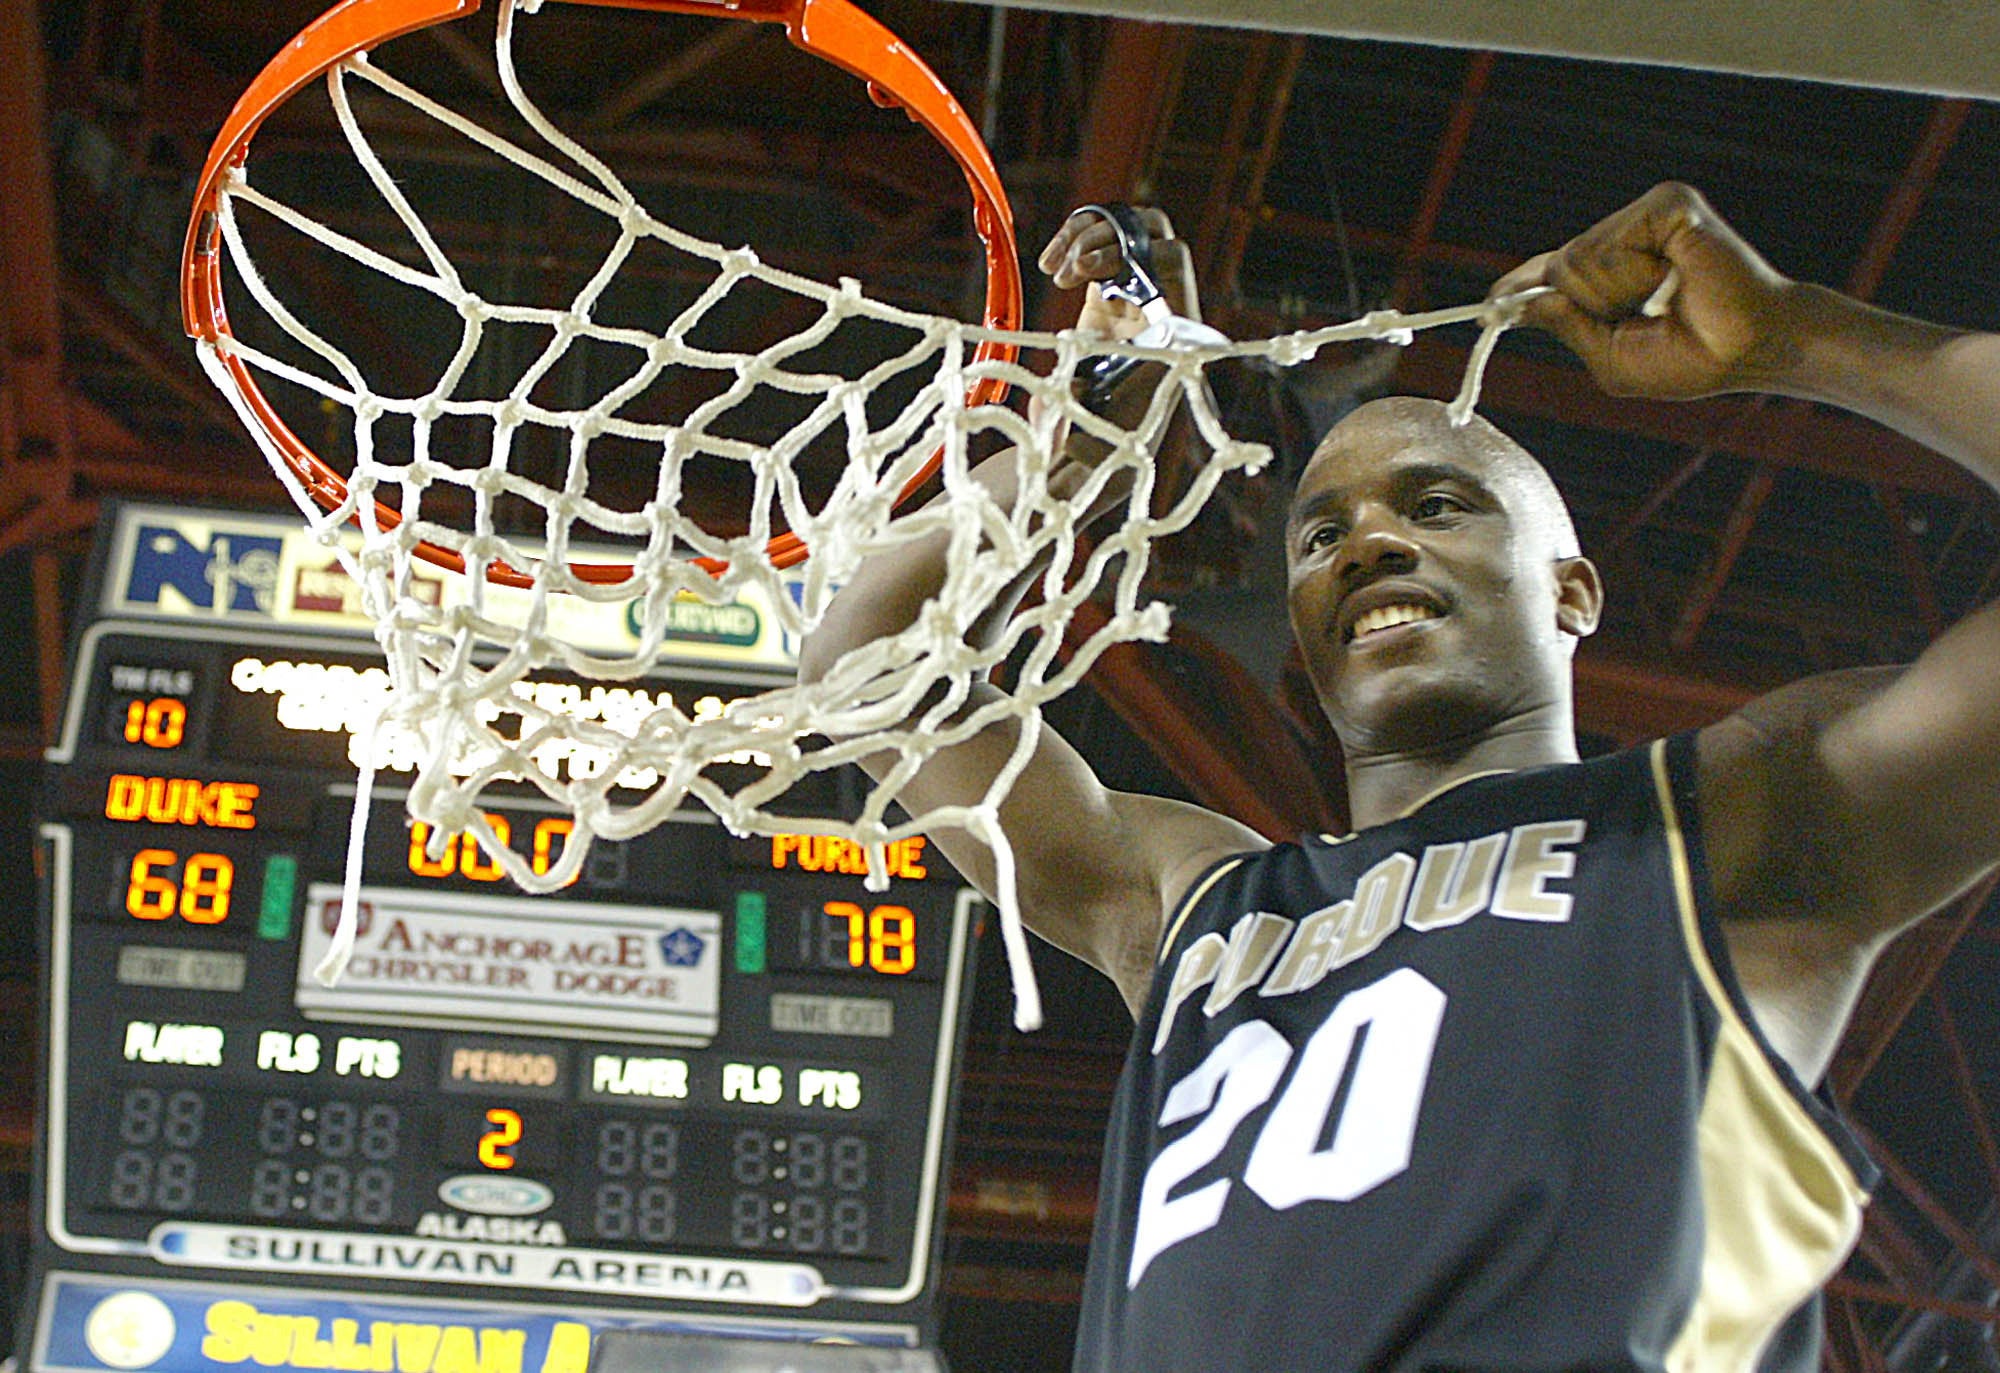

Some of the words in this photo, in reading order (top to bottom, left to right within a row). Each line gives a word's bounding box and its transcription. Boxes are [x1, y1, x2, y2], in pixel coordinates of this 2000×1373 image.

[124, 698, 187, 748] 10
[106, 775, 260, 829] DUKE
[772, 832, 927, 879] PURDUE
[125, 848, 235, 924] 68
[378, 918, 646, 969] ANCHORAGE
[823, 901, 916, 975] 78
[1151, 818, 1587, 1056] PURDUE
[346, 956, 530, 988] CHRYSLER
[553, 969, 679, 1000] DODGE
[123, 1020, 225, 1067] PLAYER
[257, 1031, 321, 1074] FLS
[335, 1037, 401, 1079] PTS
[450, 1049, 558, 1086] PERIOD
[592, 1054, 689, 1099] PLAYER
[722, 1062, 783, 1105] FLS
[799, 1068, 861, 1110] PTS
[477, 1108, 523, 1169] 2
[1127, 967, 1448, 1291] 20
[416, 1211, 567, 1246] ALASKA
[226, 1233, 513, 1276] SULLIVAN
[549, 1256, 752, 1292] ARENA
